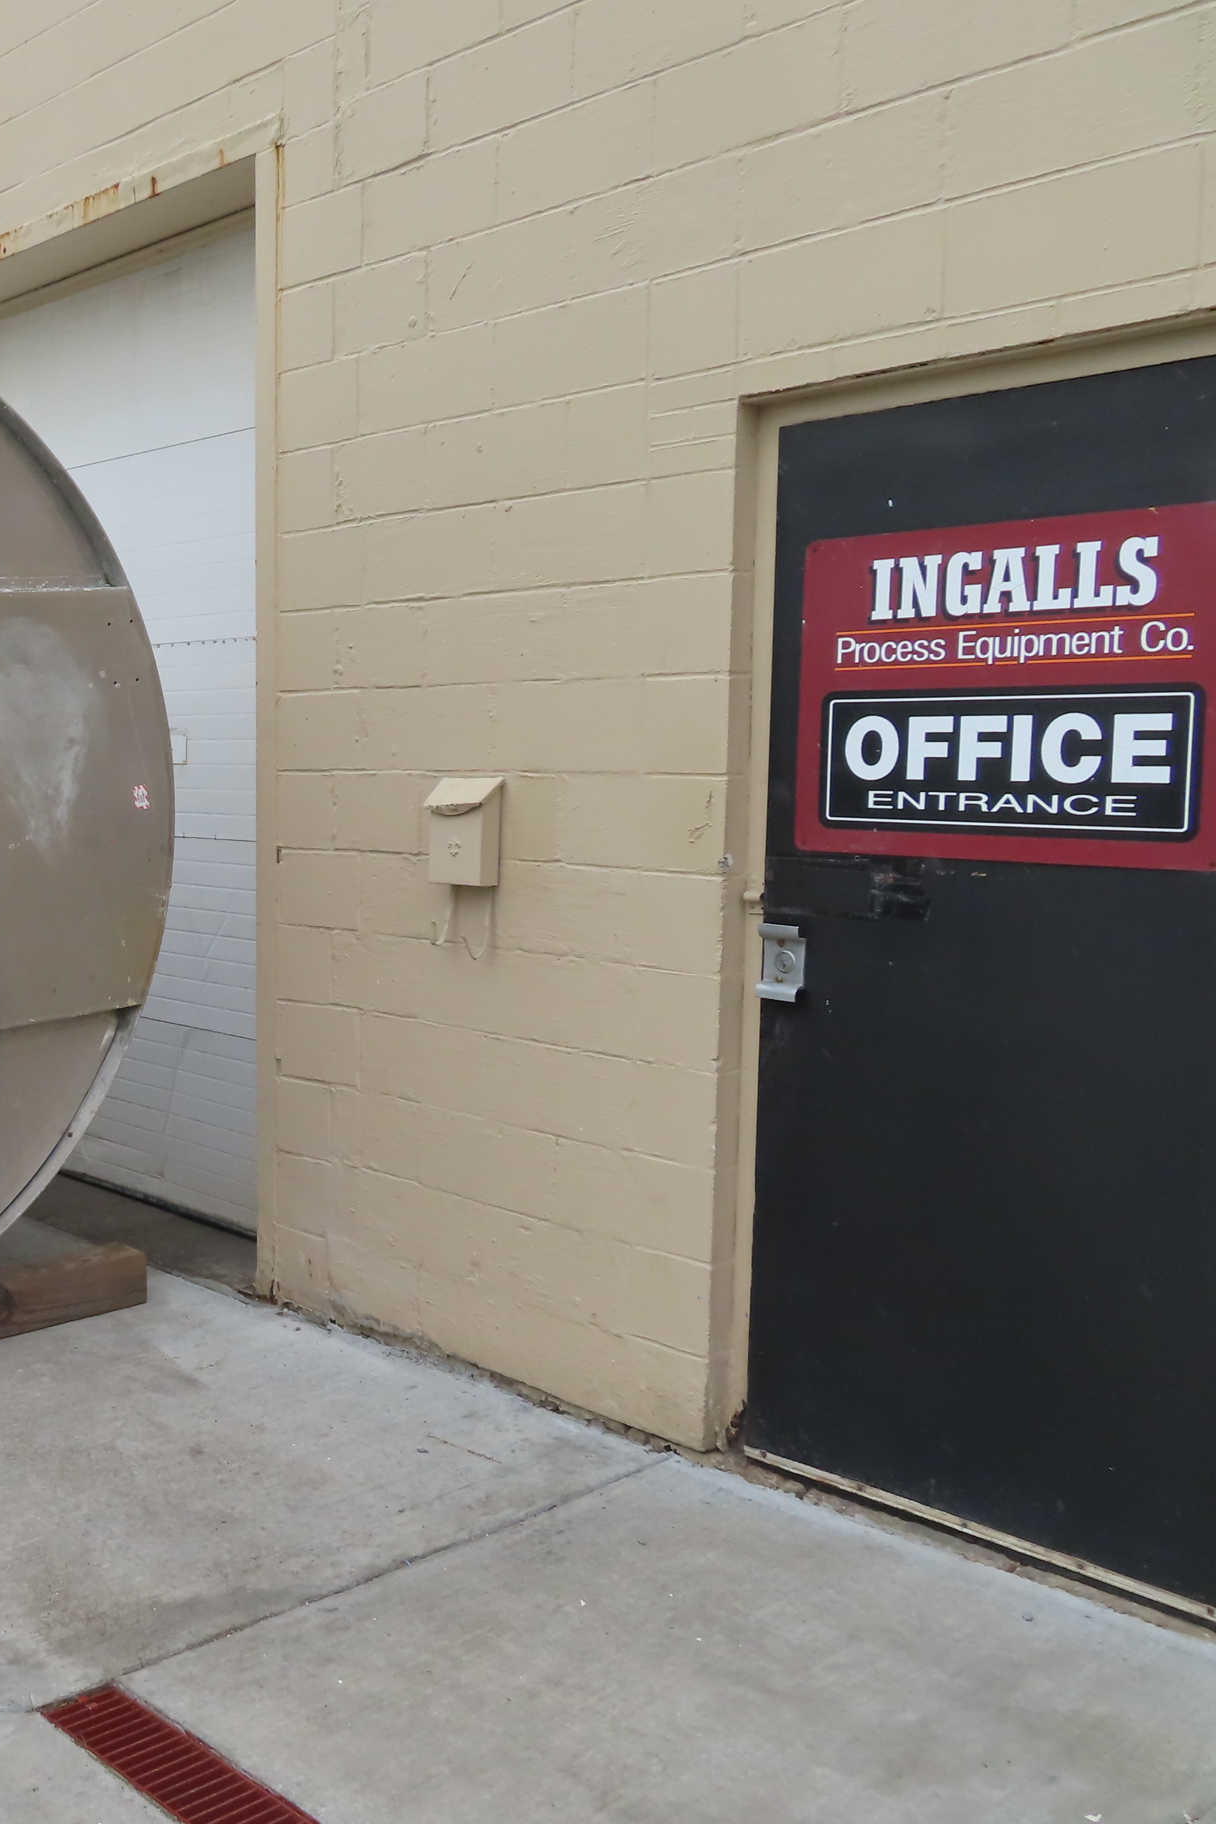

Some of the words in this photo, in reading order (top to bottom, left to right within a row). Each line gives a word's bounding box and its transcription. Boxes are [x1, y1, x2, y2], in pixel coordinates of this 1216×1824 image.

[870, 536, 1159, 621] INGALLS
[836, 635, 947, 664] Process
[957, 625, 1124, 665] Equipment
[1140, 621, 1195, 653] Co.
[844, 712, 1174, 784] OFFICE
[867, 790, 1138, 816] ENTRANCE
